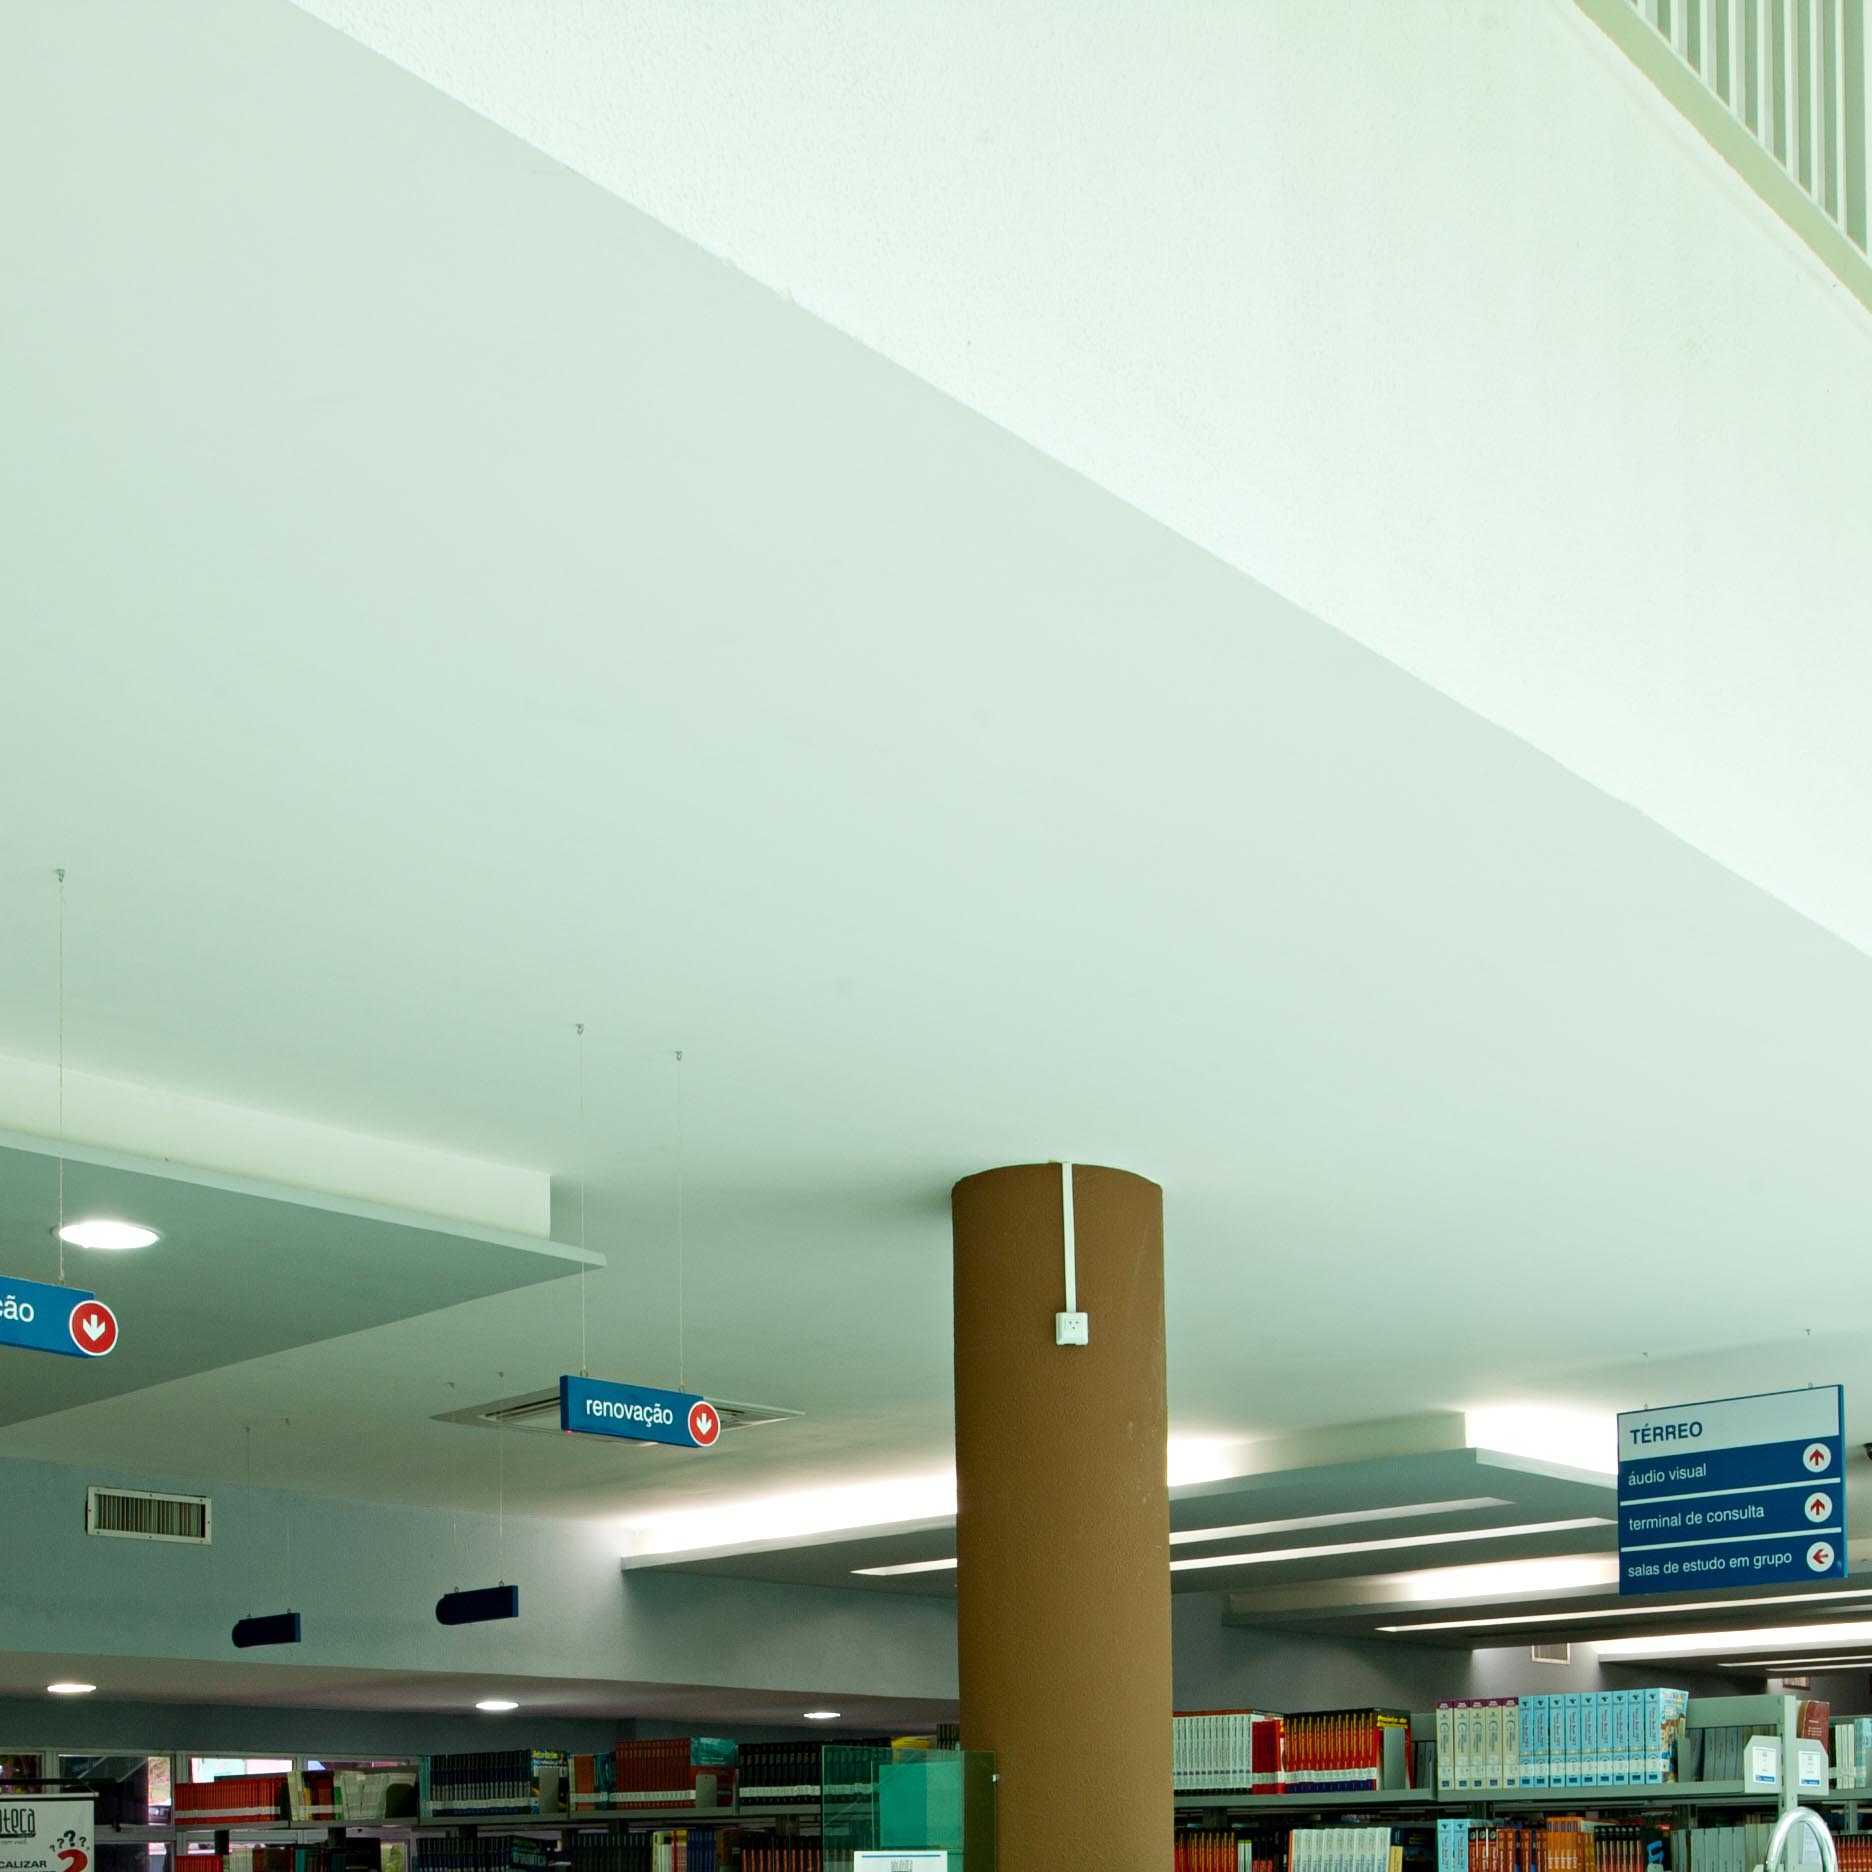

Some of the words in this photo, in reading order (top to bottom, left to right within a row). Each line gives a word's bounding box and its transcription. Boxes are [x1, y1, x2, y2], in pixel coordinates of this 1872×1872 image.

[586, 1399, 673, 1428] renovação
[1630, 1421, 1703, 1445] TÉRREO
[1628, 1470, 1665, 1486] áudio
[1668, 1462, 1707, 1480] visual
[1628, 1515, 1682, 1531] terminal
[1685, 1511, 1703, 1525] de
[1706, 1505, 1765, 1523] consulta
[1628, 1563, 1660, 1578] salas
[1663, 1561, 1679, 1575] de
[1682, 1556, 1726, 1573] estudo
[1729, 1556, 1750, 1568] em
[1753, 1552, 1793, 1570] grupo
